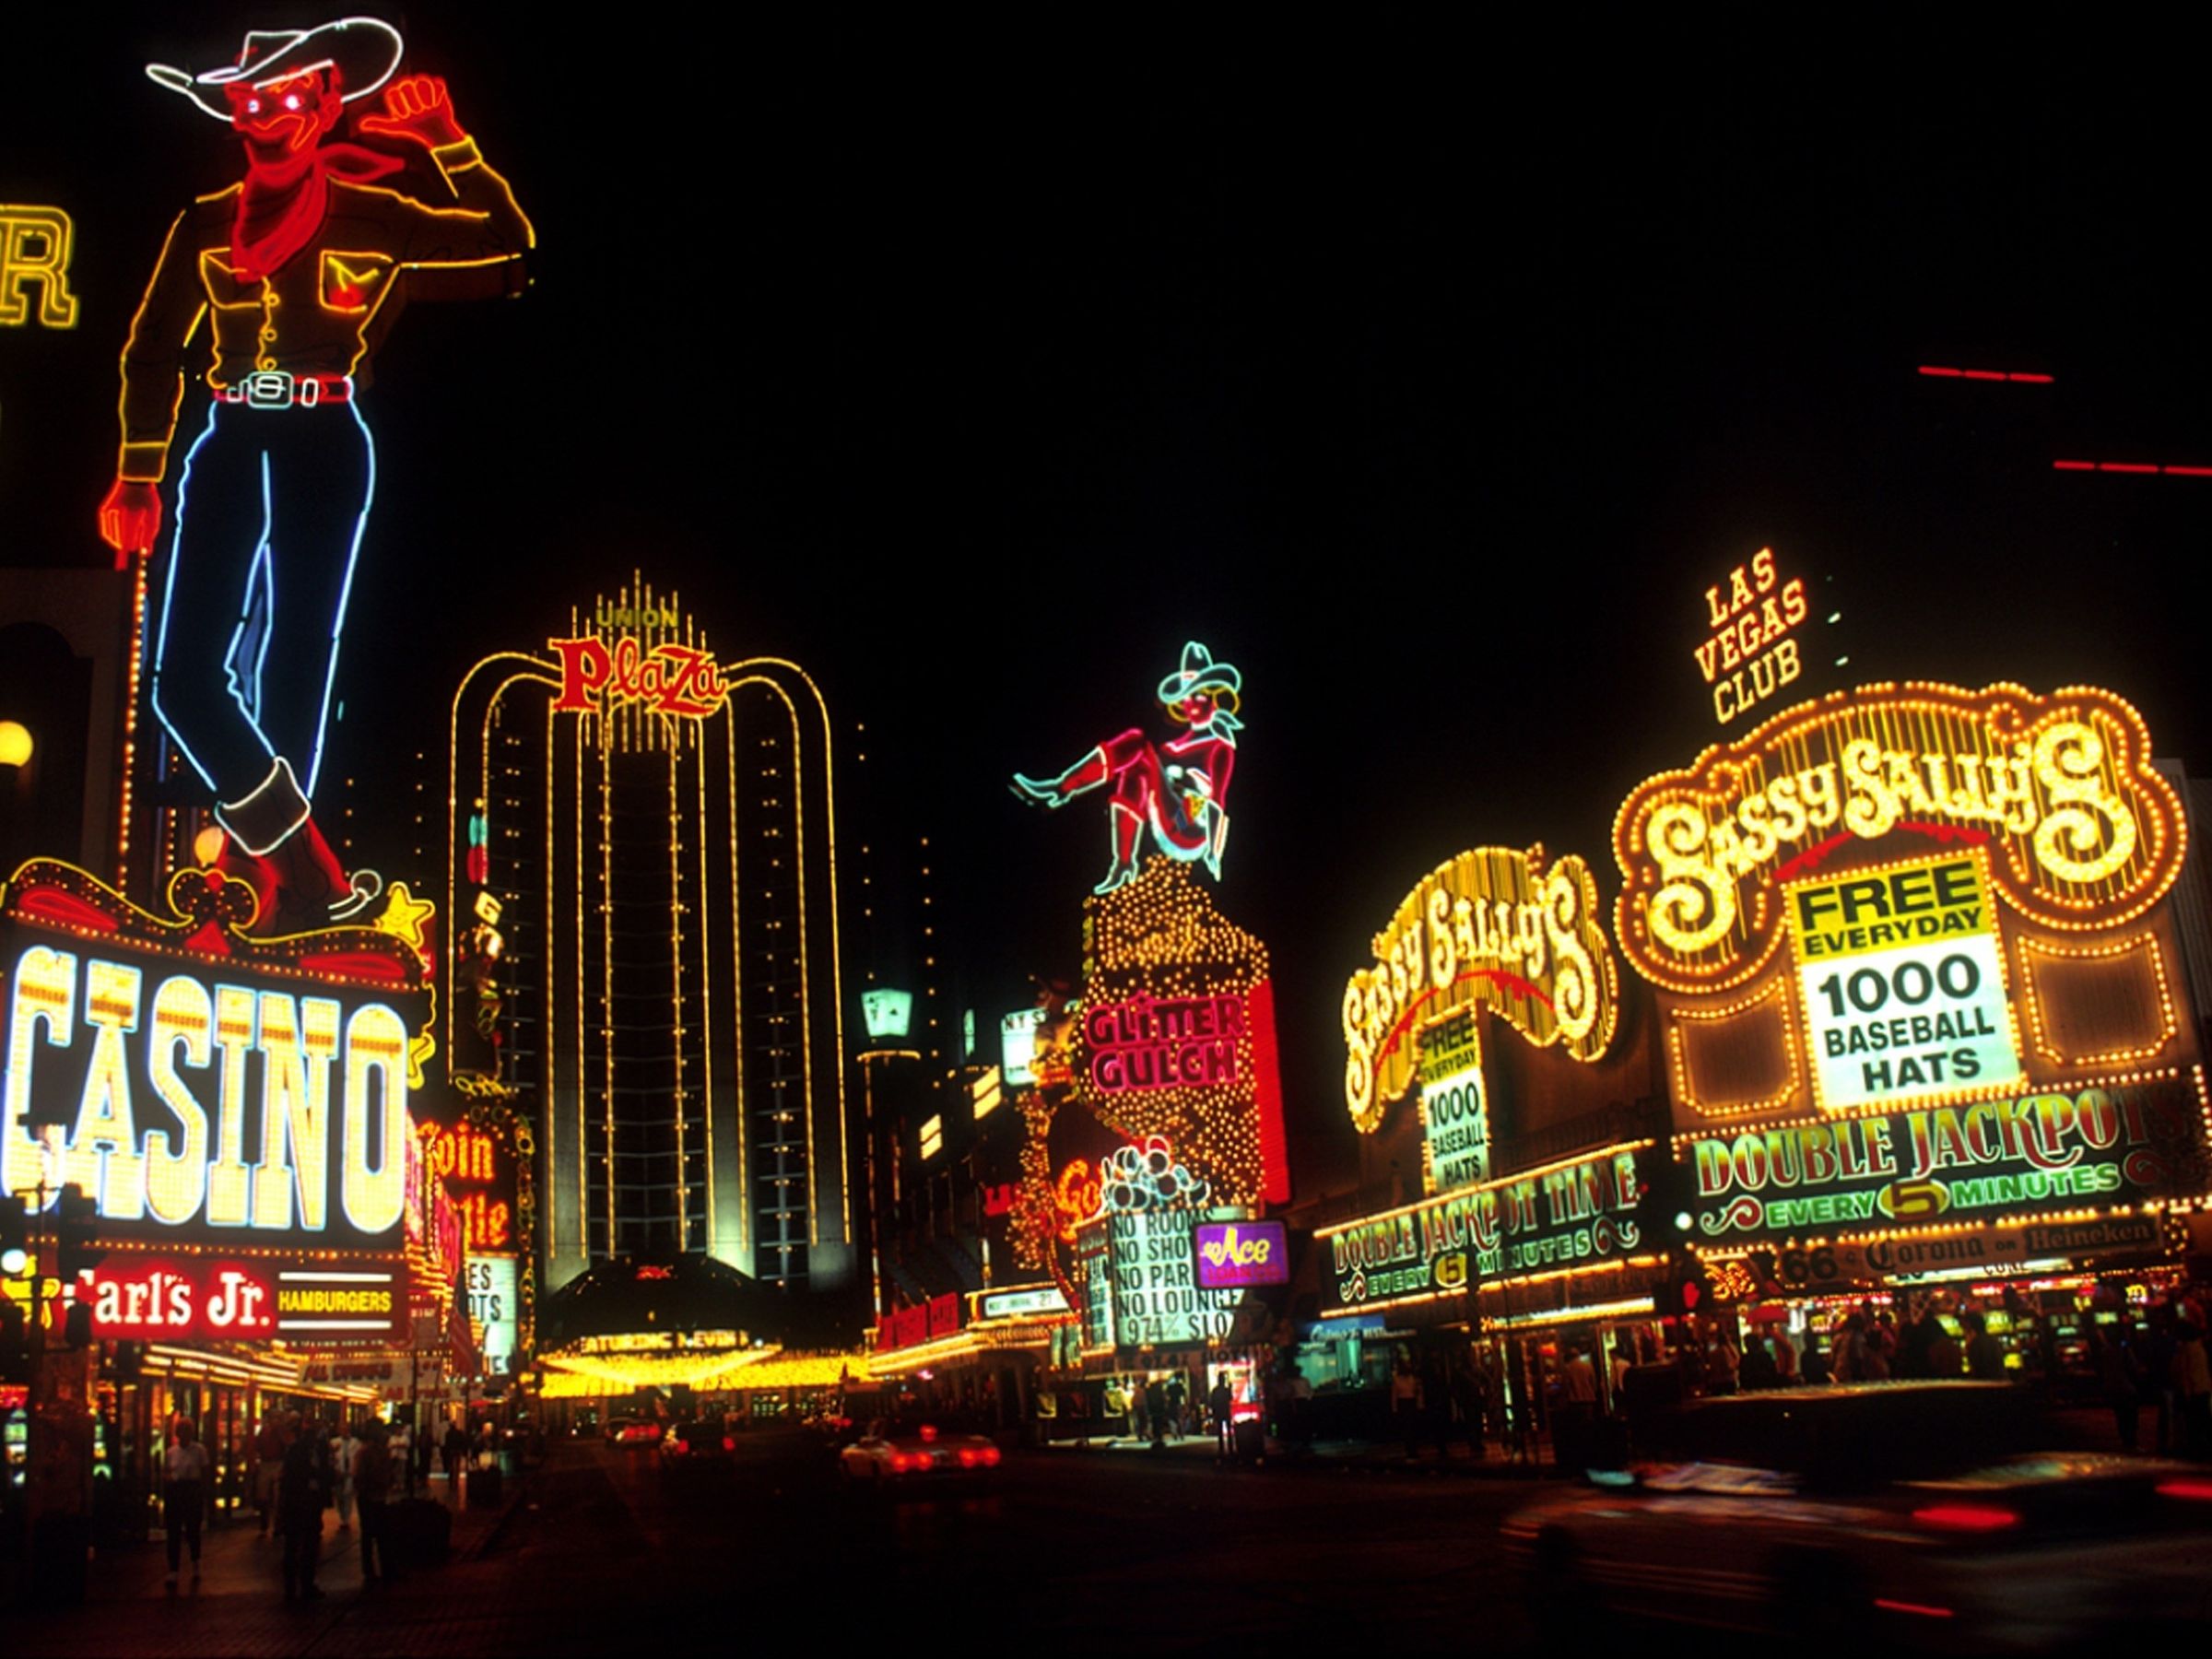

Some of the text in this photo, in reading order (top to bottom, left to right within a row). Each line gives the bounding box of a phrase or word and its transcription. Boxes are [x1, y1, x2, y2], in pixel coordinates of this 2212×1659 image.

[1705, 547, 1776, 628] LAS
[595, 608, 678, 628] UNION
[1694, 578, 1808, 682] VEGAS
[547, 635, 725, 719] Plaza
[1712, 637, 1801, 724] CLUB
[1796, 861, 1979, 931] FREE
[1803, 907, 1982, 956] EVERYDAY
[1818, 953, 1981, 1017] 1000
[1421, 1009, 1474, 1057] FREE
[1824, 1006, 1995, 1058] BASEBALL
[0, 945, 408, 1233] CASINO
[1092, 1040, 1239, 1093] GULCH
[1422, 1049, 1476, 1084] EVERYDAY
[1862, 1048, 1982, 1092] HATS
[1429, 1081, 1479, 1128] 1000
[1431, 1121, 1485, 1159] BASEBALL
[1693, 1117, 1898, 1196] DOUBLE
[1443, 1155, 1481, 1186] HATS
[1333, 1214, 1417, 1276] DOUBLE
[1543, 1151, 1641, 1224] TIME
[1765, 1163, 2122, 1229] EVERY 5 MINUTES
[1112, 1213, 1136, 1239] NO
[1114, 1240, 1139, 1265] NO
[1147, 1235, 1188, 1261] SHO
[1204, 1226, 1270, 1267] Ace
[469, 1263, 491, 1290] ES
[1115, 1262, 1191, 1290] NO PAR
[1783, 1247, 1839, 1284] 66
[1864, 1235, 1986, 1274] Corona
[2030, 1222, 2152, 1253] Heineken
[206, 1271, 269, 1325] Jr.
[278, 1291, 392, 1312] HAMBURGERS
[1118, 1288, 1238, 1318] NO LOUNGE
[1368, 1265, 1431, 1296] EVERY
[1188, 1312, 1229, 1342] SLO
